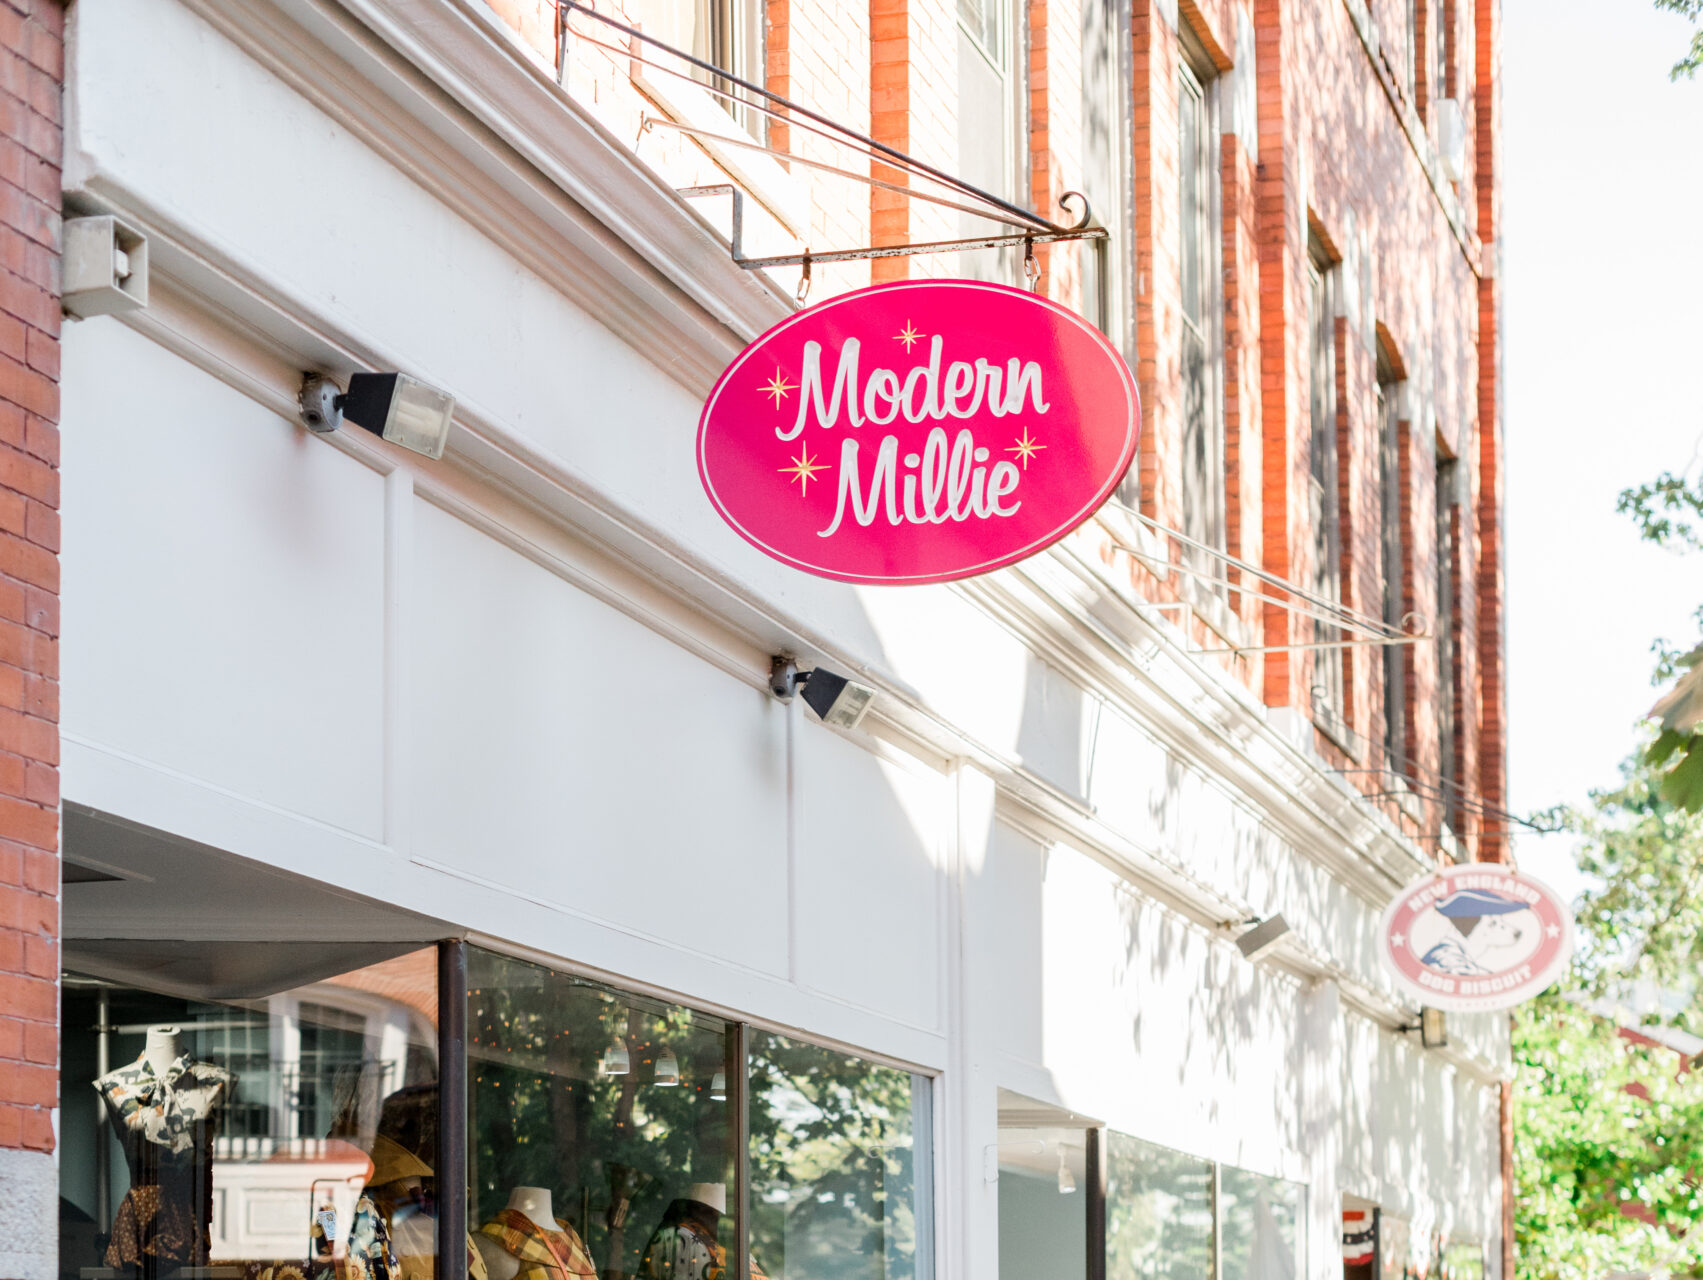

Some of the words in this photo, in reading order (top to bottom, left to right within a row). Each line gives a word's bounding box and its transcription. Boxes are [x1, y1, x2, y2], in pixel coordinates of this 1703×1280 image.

[775, 334, 1050, 441] Modern
[817, 427, 1021, 538] Millie
[1407, 880, 1448, 912] NEW
[1454, 875, 1541, 905] ENGLAND
